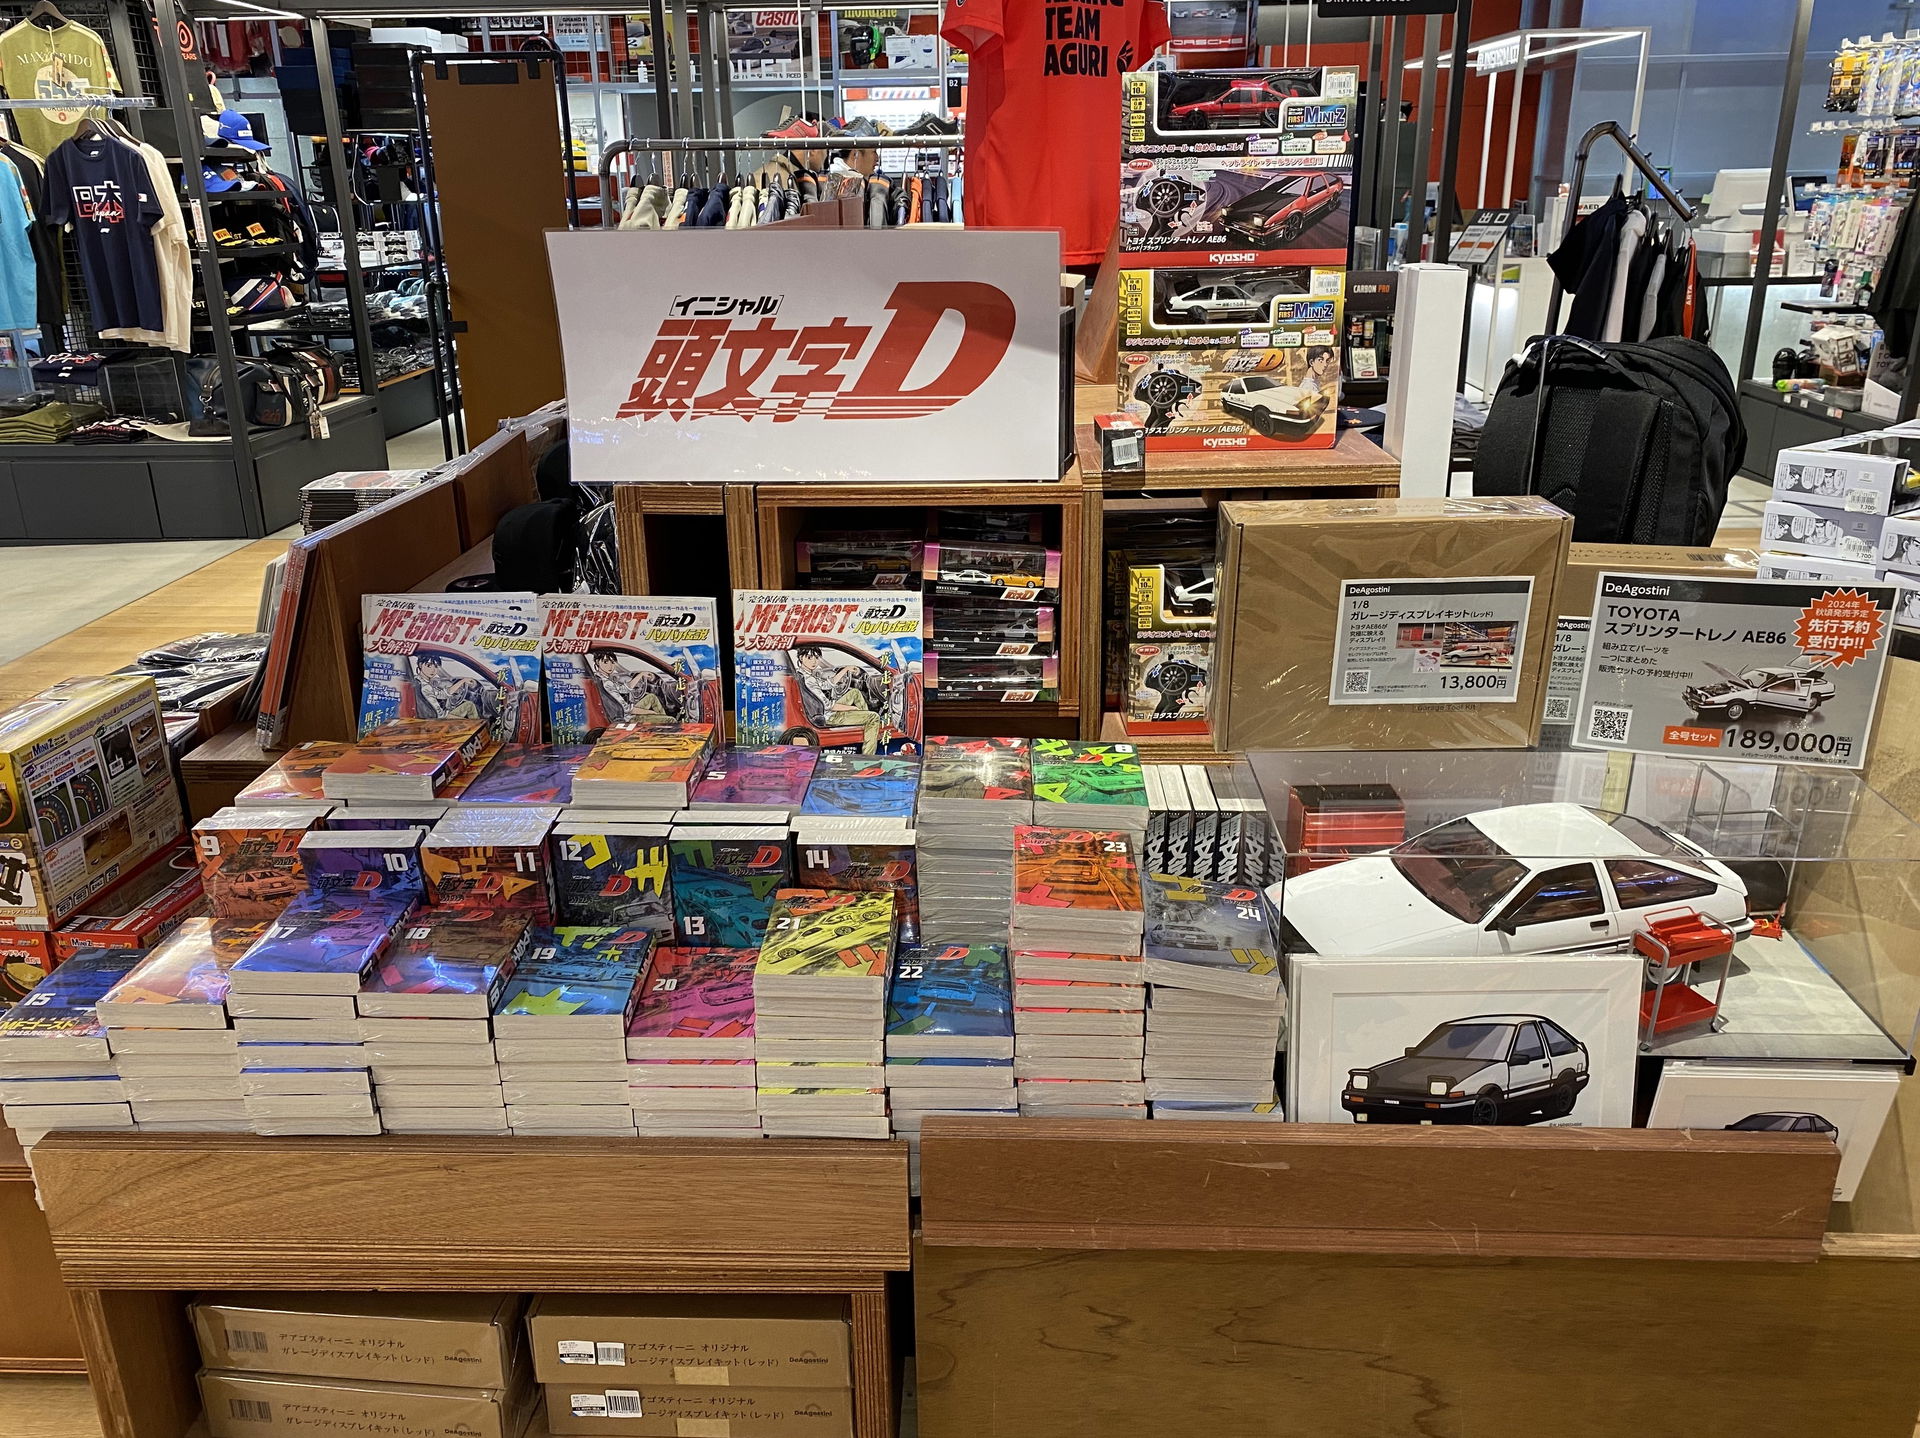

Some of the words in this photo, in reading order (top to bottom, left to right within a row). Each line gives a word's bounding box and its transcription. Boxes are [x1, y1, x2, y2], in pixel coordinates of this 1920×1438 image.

[1045, 7, 1100, 41] TEAM
[1043, 44, 1108, 77] AGURI
[1478, 212, 1510, 224] 出口
[1126, 237, 1148, 246] トヨタ
[1148, 236, 1206, 245] スプリンタートレノ
[1206, 236, 1227, 244] AE86
[1209, 253, 1256, 264] KYOSHO
[1353, 284, 1377, 294] CARBON
[1378, 284, 1391, 293] PRO
[1203, 437, 1248, 448] KYOSHO
[1350, 586, 1390, 596] DeAgostini
[1605, 582, 1670, 596] DeAgostini
[1352, 600, 1369, 609] 1/8
[1827, 600, 1860, 608] 2024年
[745, 604, 787, 634] MF
[784, 604, 859, 634] GHOST
[1607, 605, 1680, 622] TOYOTA
[367, 608, 411, 637] MF
[405, 613, 482, 645] GHOST
[541, 609, 577, 638] MF
[575, 611, 649, 640] GHOST
[1350, 623, 1387, 631] トヨタAE86が
[1808, 618, 1871, 635] 先行予約
[1555, 634, 1572, 642] 1/8
[1604, 622, 1737, 642] スプリンタートレノ
[1742, 630, 1787, 645] AE86
[367, 638, 419, 656] 大解剖
[544, 639, 591, 654] 大解剖
[745, 634, 796, 650] 大解剖
[1602, 642, 1670, 655] 組み立てパーツを
[1600, 655, 1657, 666] 一つにまとめた
[1669, 730, 1717, 743] 全号セット
[825, 755, 845, 763] 6
[706, 772, 728, 781] 5
[200, 836, 220, 856] 9
[558, 840, 583, 861] 12
[1103, 840, 1127, 853] 23
[383, 853, 409, 872] 10
[514, 852, 536, 872] 11
[805, 849, 830, 869] 14
[1235, 906, 1261, 922] 24
[683, 916, 705, 935] 13
[776, 918, 800, 930] 21
[273, 926, 299, 939] 17
[405, 928, 431, 939] 18
[531, 948, 557, 960] 19
[899, 966, 923, 979] 22
[652, 978, 678, 992] 20
[24, 993, 56, 1006] 15
[359, 1337, 406, 1349] オリジナル
[701, 1343, 749, 1353] オリジナル
[444, 1355, 482, 1363] DeAgostini
[789, 1356, 829, 1364] DeAgostini
[708, 1397, 754, 1406] オリジナル
[361, 1410, 407, 1421] オリジナル
[794, 1409, 832, 1417] DeAgostini
